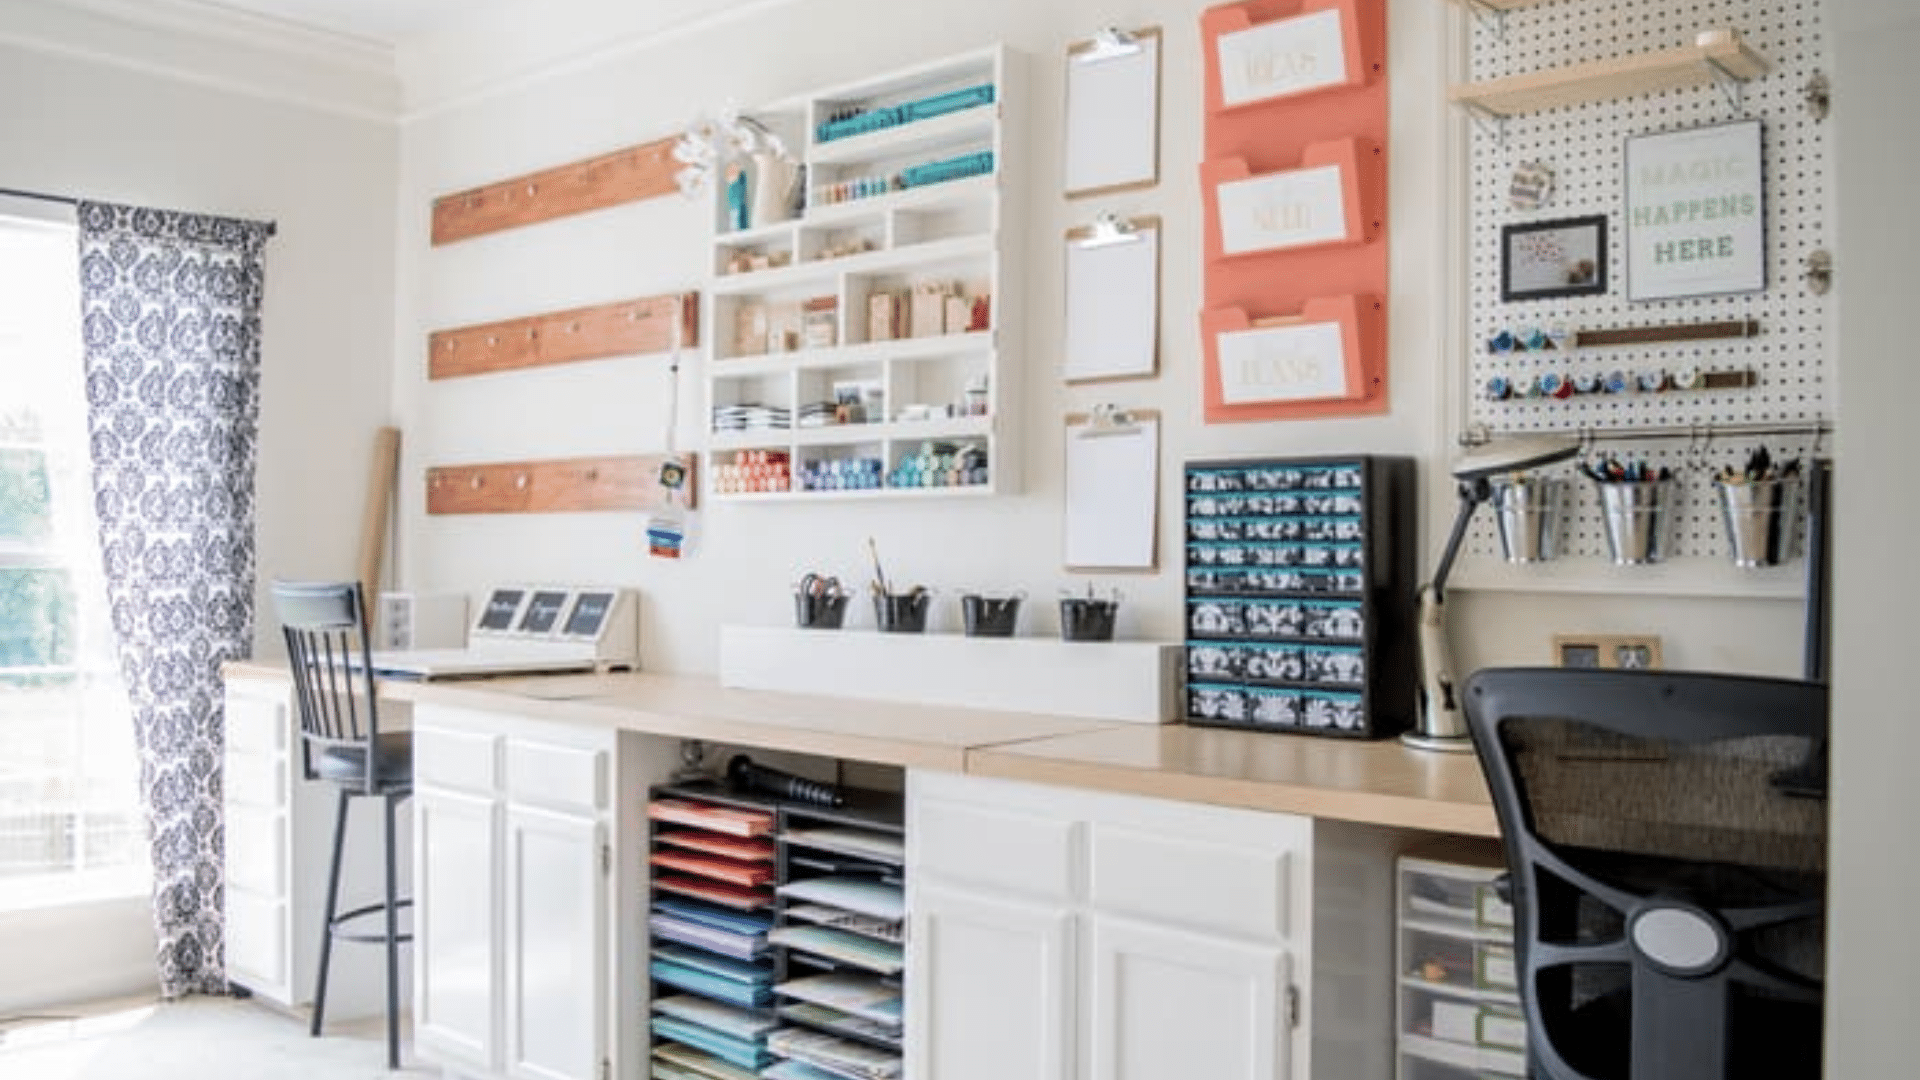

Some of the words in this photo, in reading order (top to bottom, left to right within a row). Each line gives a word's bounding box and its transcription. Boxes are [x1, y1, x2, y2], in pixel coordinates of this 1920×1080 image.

[1640, 153, 1745, 185] MAGIC
[1634, 192, 1755, 227] HAPPENS
[1654, 234, 1734, 264] HERE
